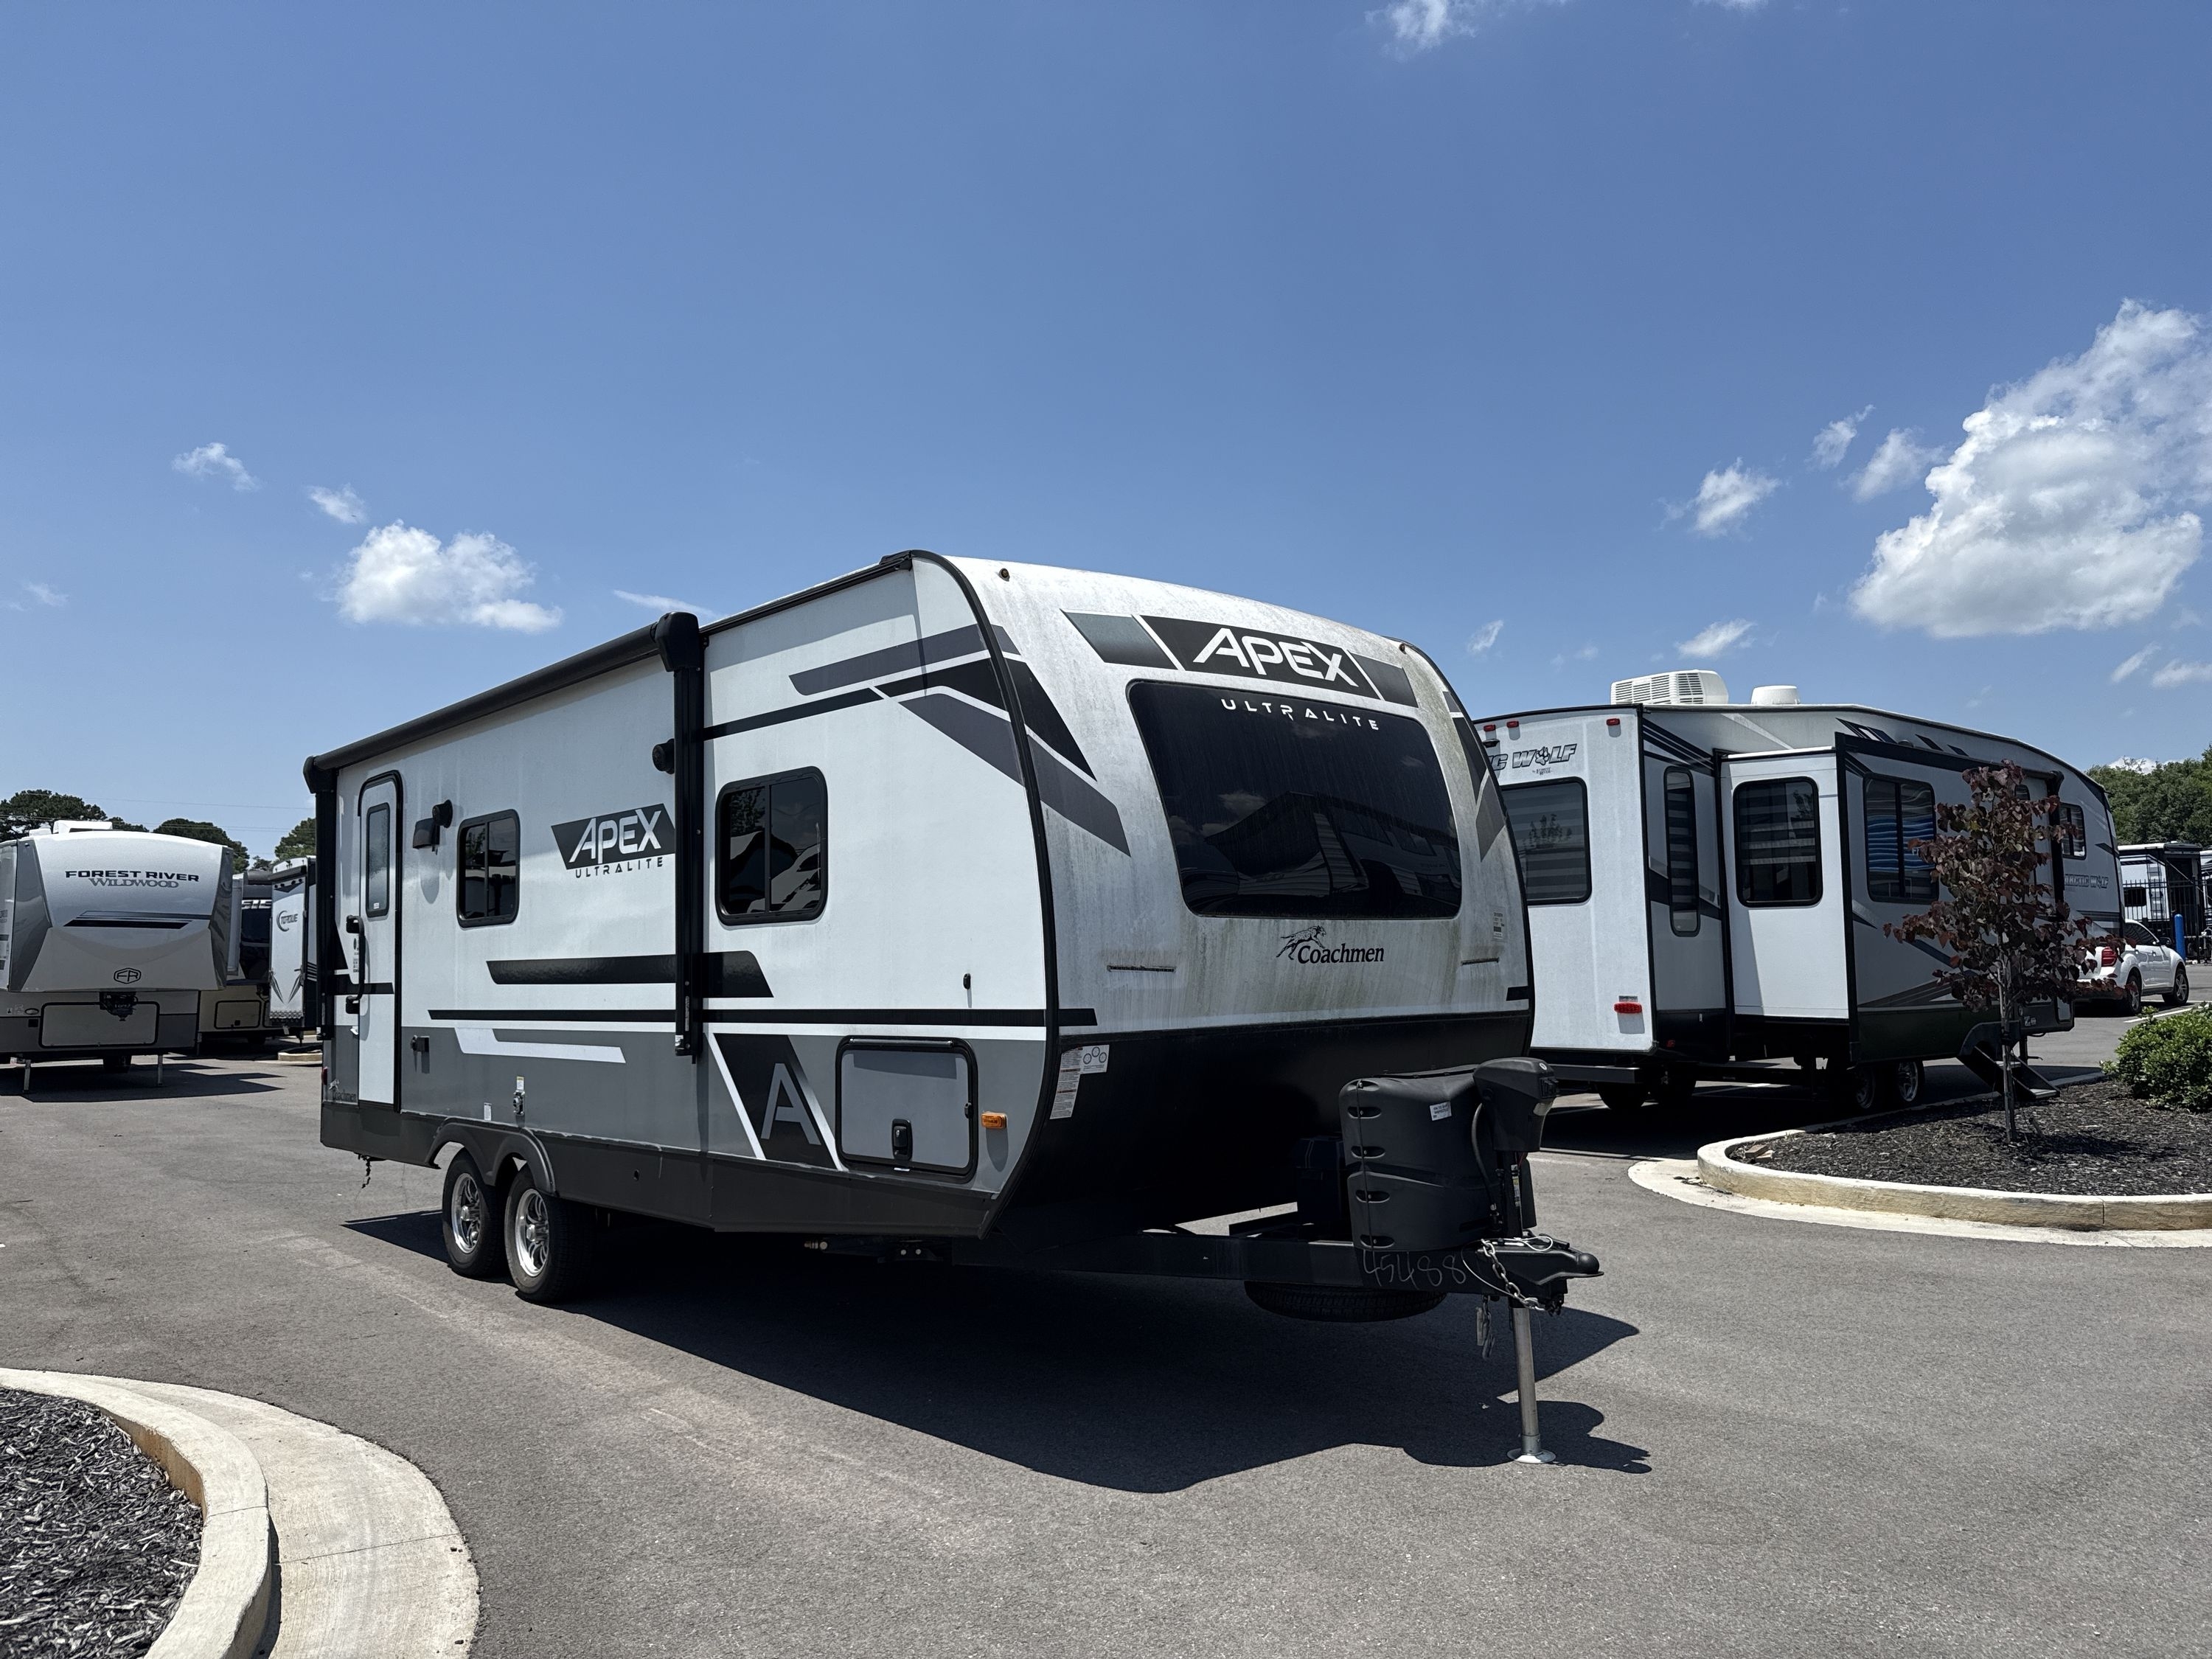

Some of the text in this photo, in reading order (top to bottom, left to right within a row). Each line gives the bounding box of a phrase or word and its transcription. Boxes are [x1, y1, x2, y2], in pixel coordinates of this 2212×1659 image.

[1192, 627, 1360, 688] APEX
[1220, 698, 1380, 731] ULTRALITE
[568, 809, 662, 864] APEX
[65, 870, 200, 883] FOREST RIVER
[88, 878, 179, 888] WILDWOOD
[575, 857, 663, 878] ULTRALITE
[1297, 942, 1385, 964] Coachmen
[760, 1062, 822, 1146] A
[1363, 1249, 1467, 1290] 45488
